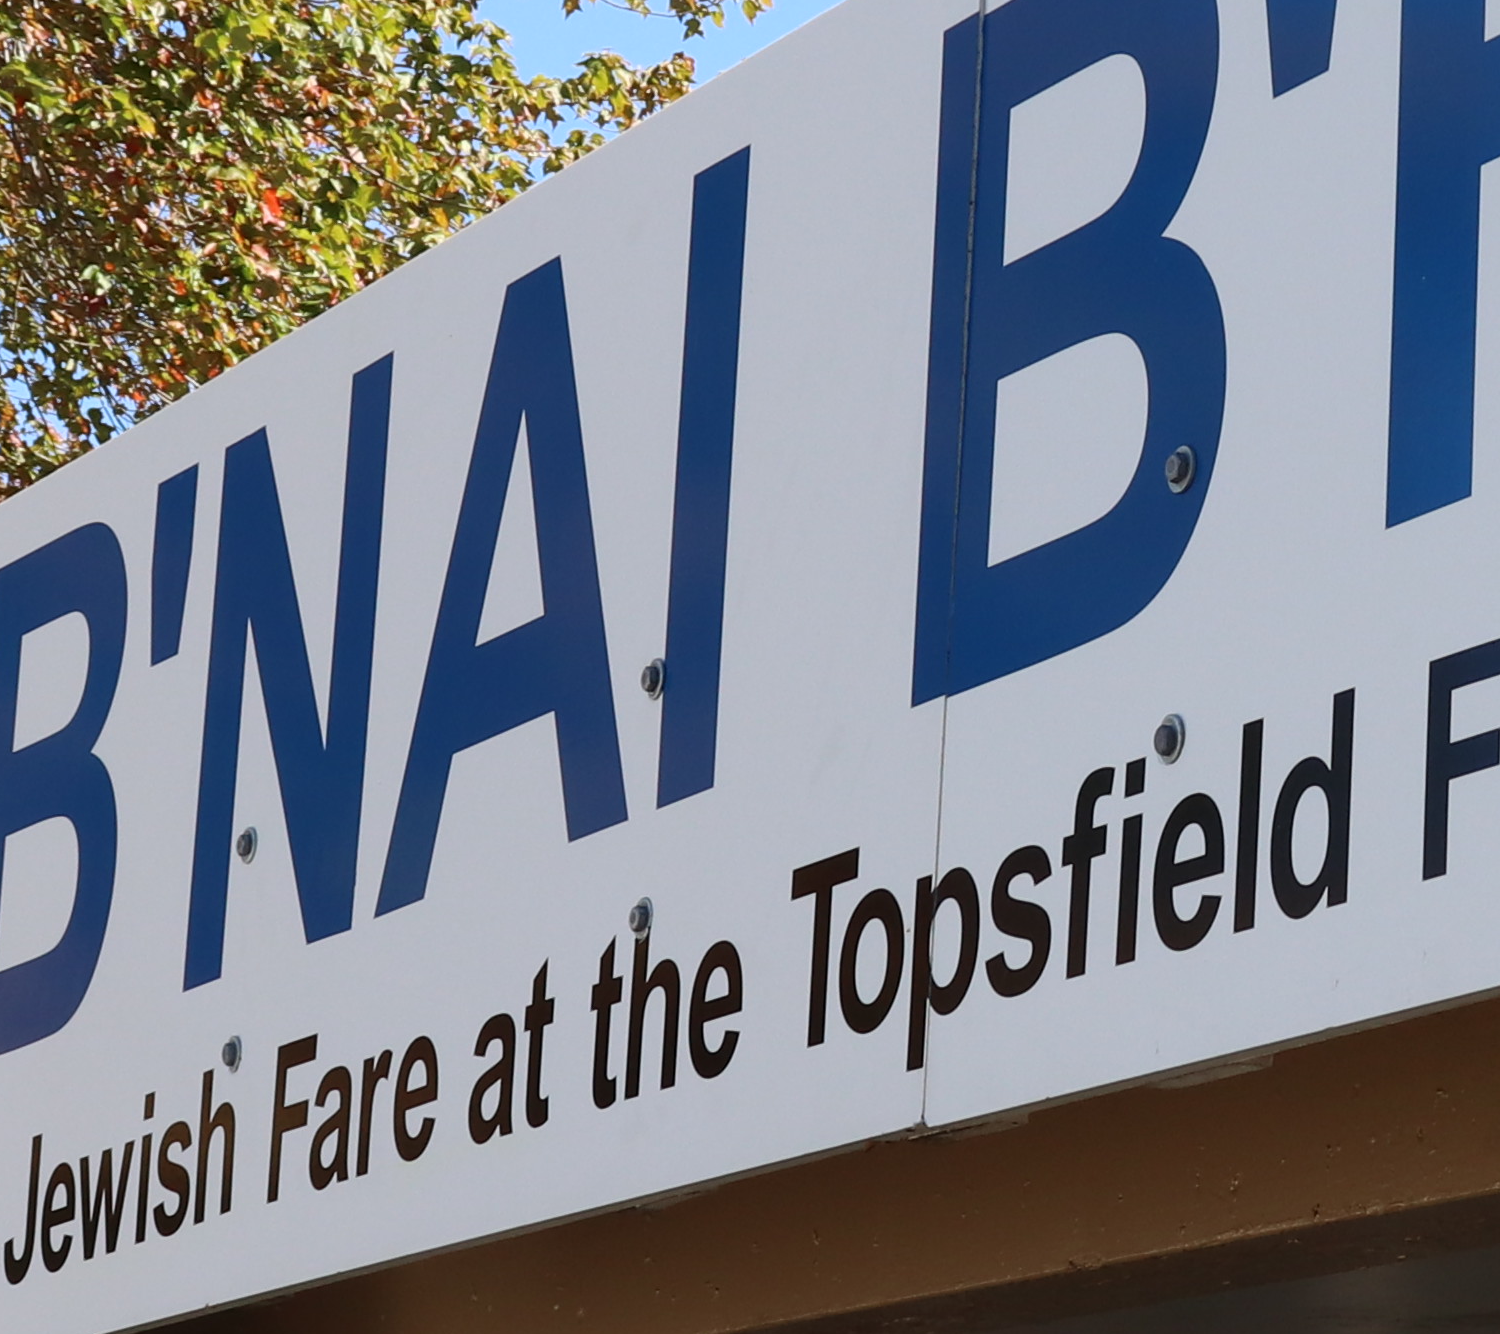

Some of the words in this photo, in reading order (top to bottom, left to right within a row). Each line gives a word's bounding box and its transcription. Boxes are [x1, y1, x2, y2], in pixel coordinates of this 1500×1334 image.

[4, 1070, 234, 1285] Jewish
[266, 1034, 438, 1203] Fare
[468, 958, 555, 1144] at
[590, 935, 743, 1108] the
[792, 687, 1355, 1071] Topsfield
